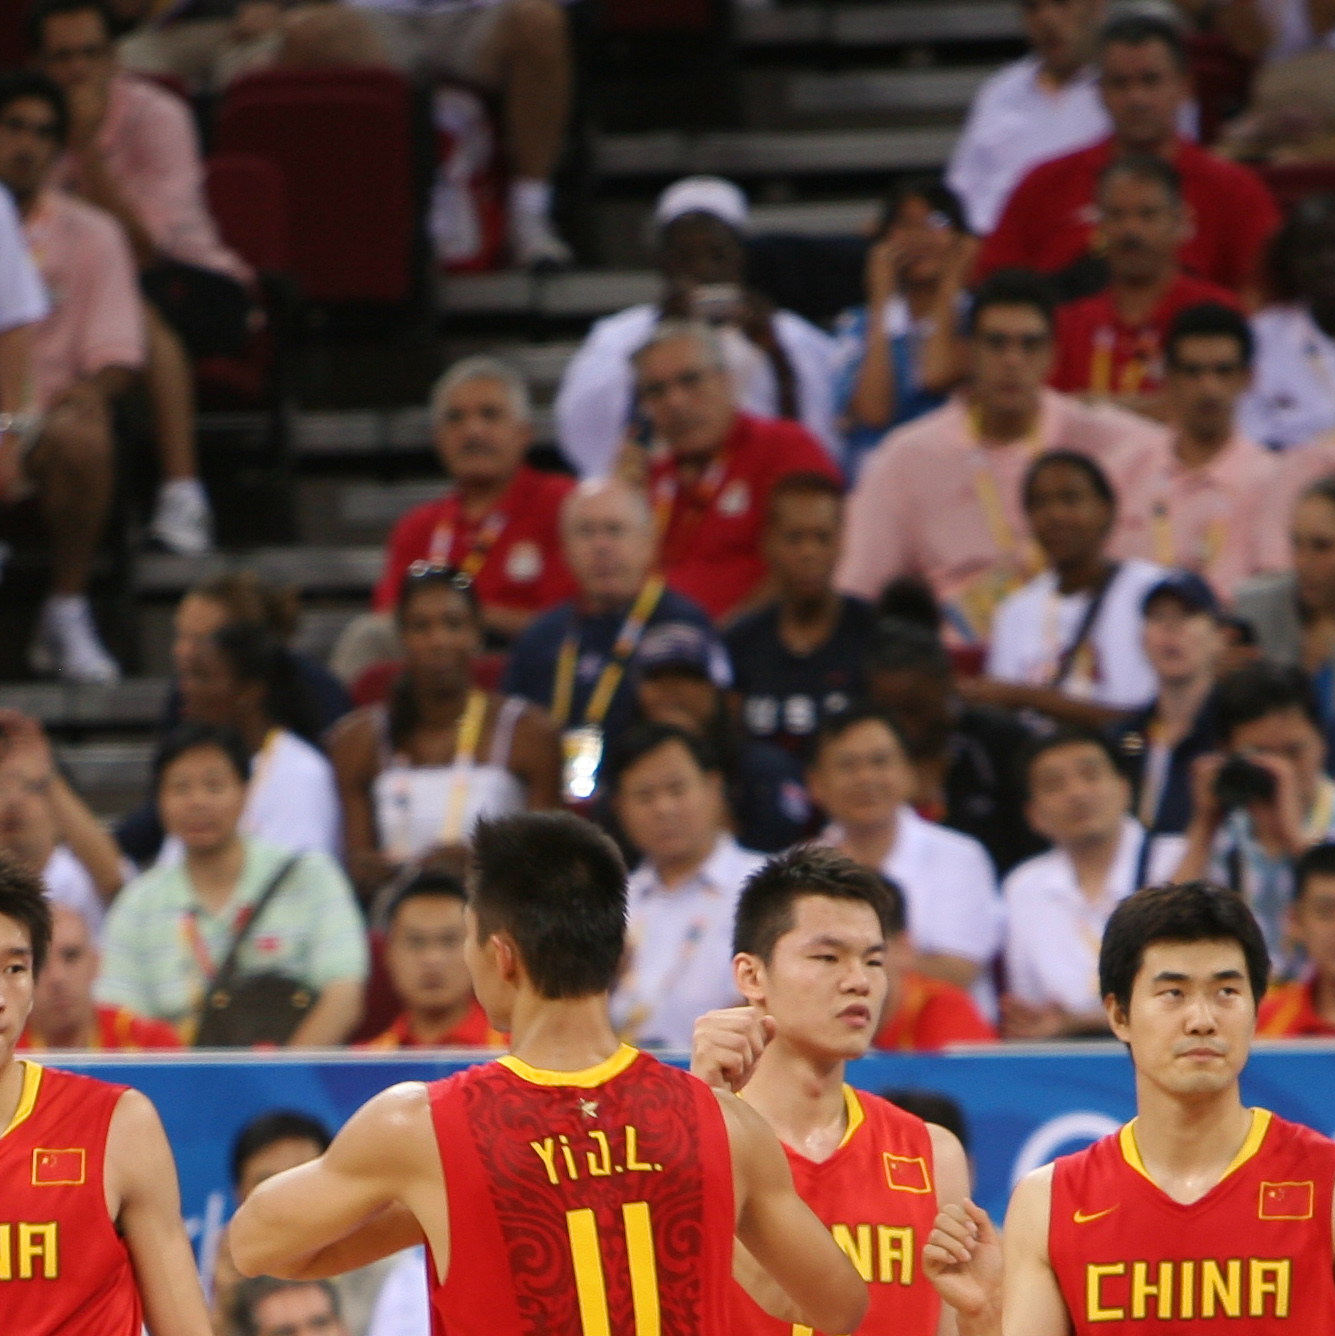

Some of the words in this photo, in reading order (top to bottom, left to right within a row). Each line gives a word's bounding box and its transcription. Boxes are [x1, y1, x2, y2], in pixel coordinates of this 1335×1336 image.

[530, 1134, 580, 1185] Yi
[585, 1125, 663, 1176] J.L.
[1085, 1257, 1291, 1323] CHINA
